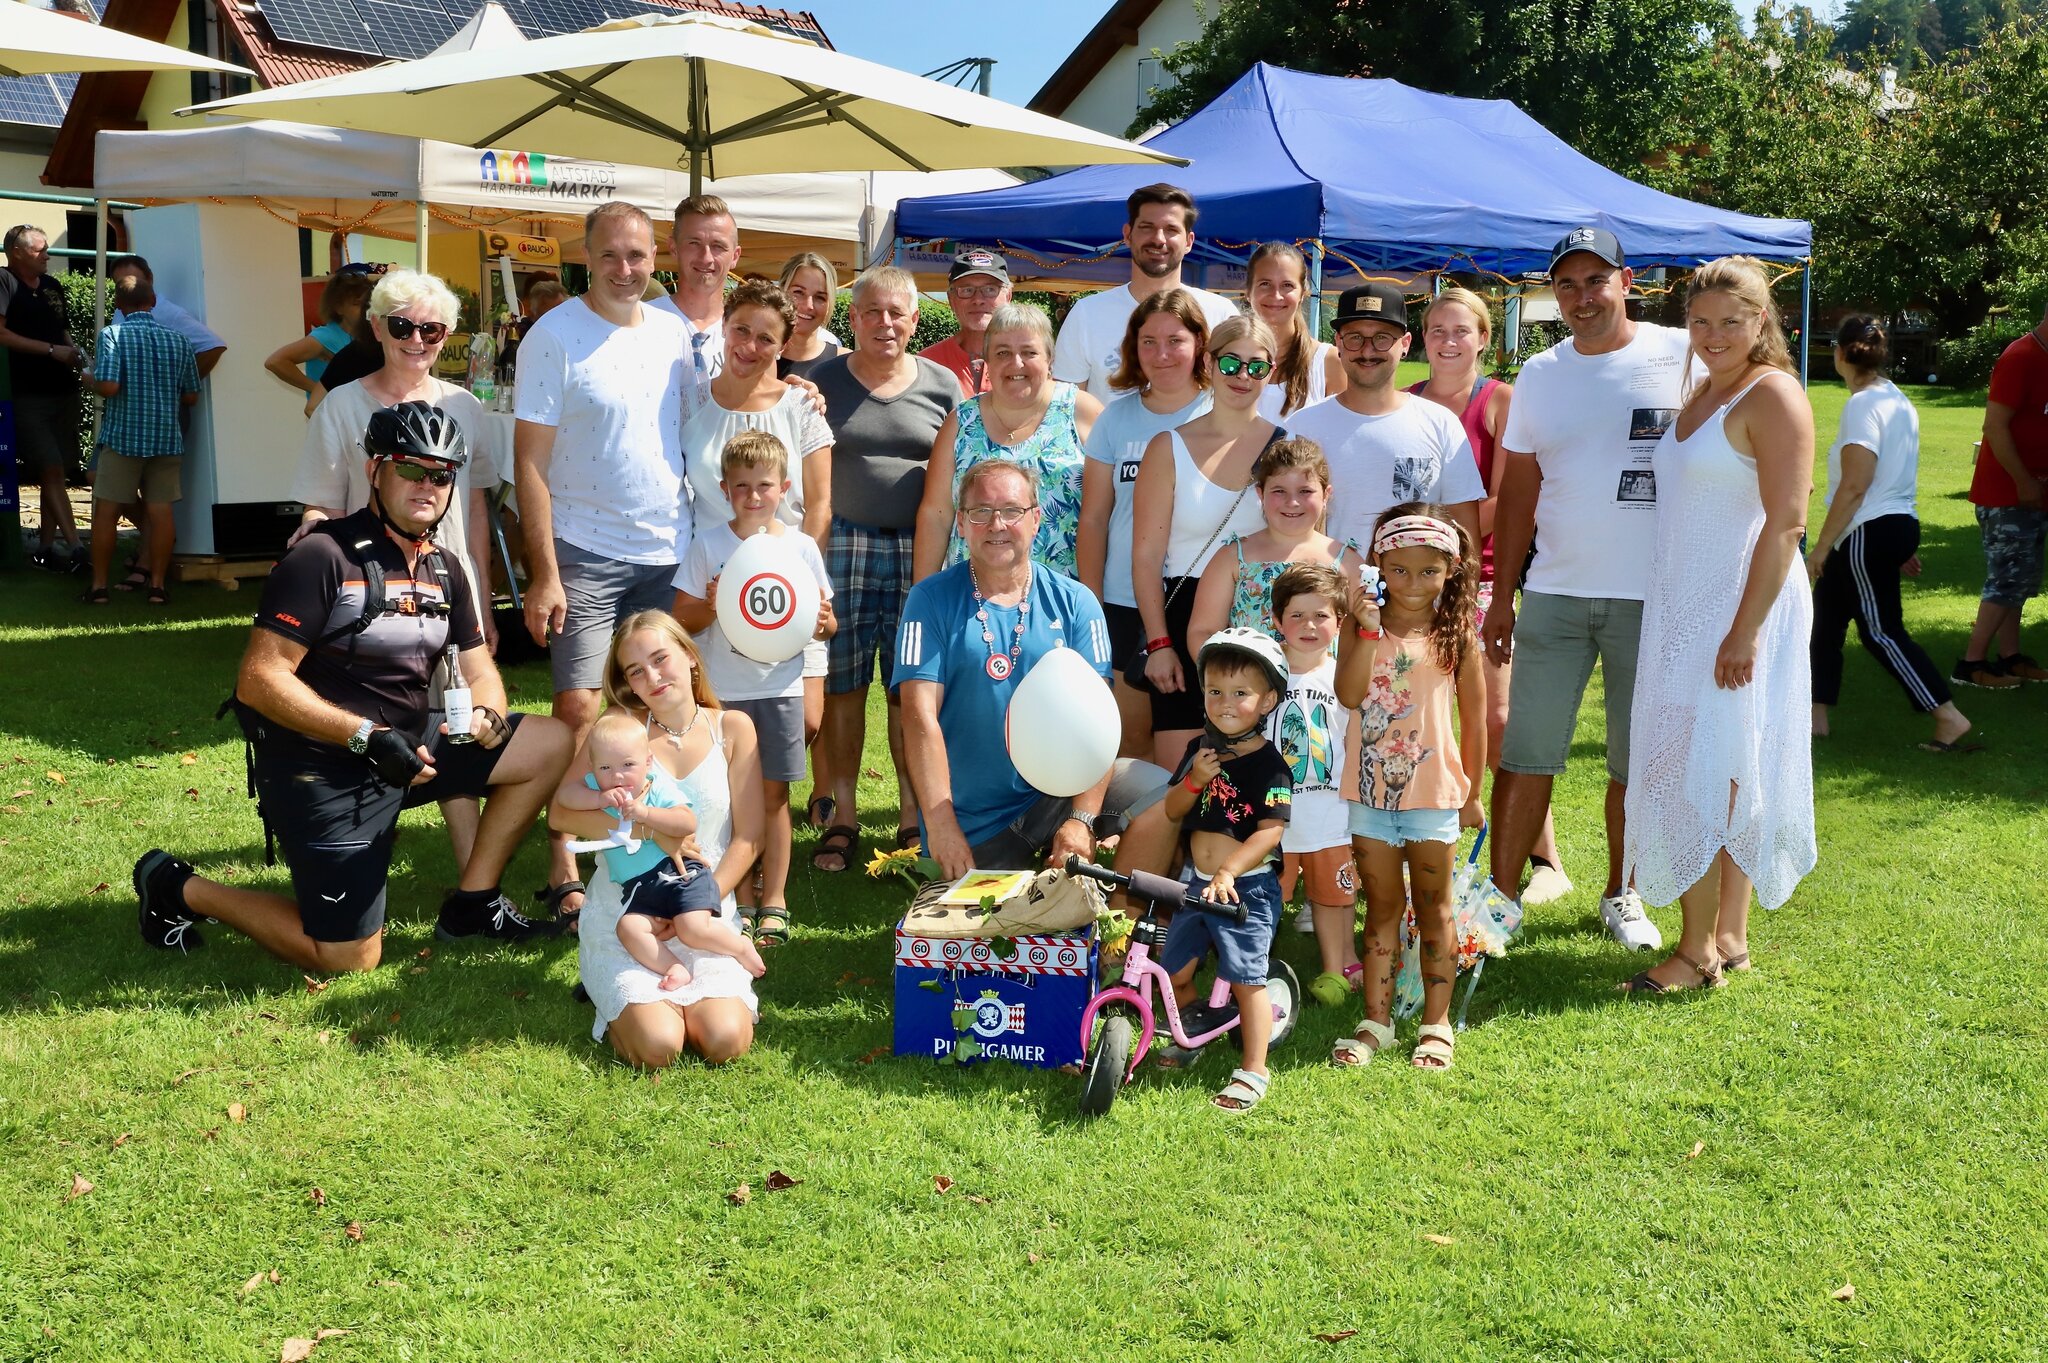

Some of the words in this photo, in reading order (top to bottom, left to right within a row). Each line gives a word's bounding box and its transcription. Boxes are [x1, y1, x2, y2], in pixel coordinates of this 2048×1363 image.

[552, 166, 616, 185] ALTSTADT
[480, 182, 546, 198] HARTBERG
[550, 181, 616, 199] MARKT
[527, 244, 550, 254] RAUCH
[909, 253, 952, 262] HARTBER
[1226, 271, 1245, 280] HART
[441, 344, 468, 361] RAUC
[1120, 441, 1147, 459] JU
[1122, 464, 1139, 478] YO
[749, 585, 786, 615] 60
[275, 613, 301, 627] KTM
[993, 660, 1006, 673] 60
[1306, 689, 1335, 705] TIME
[914, 944, 927, 953] 60
[945, 946, 959, 955] 60
[974, 948, 988, 957] 60
[1032, 951, 1045, 960] 60
[1061, 953, 1074, 962] 60
[934, 1038, 1044, 1061] PUIGAMER
